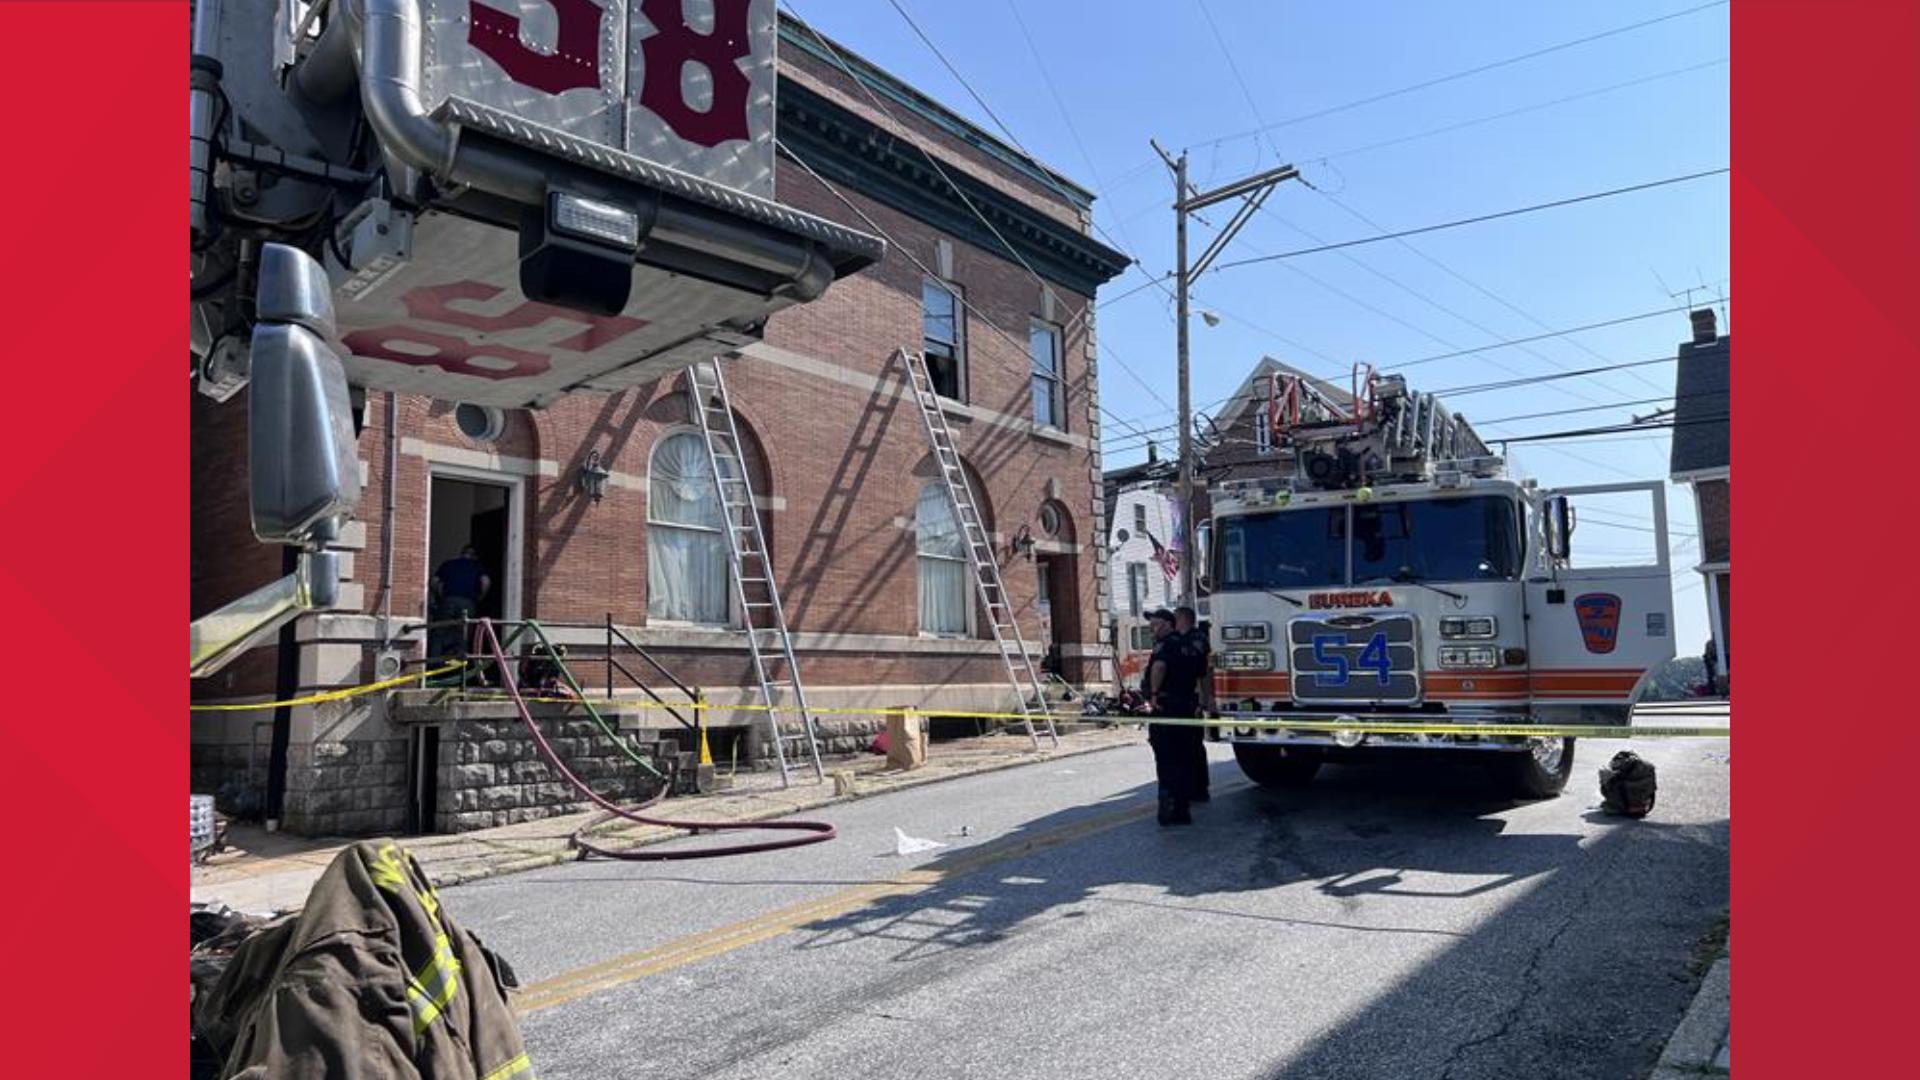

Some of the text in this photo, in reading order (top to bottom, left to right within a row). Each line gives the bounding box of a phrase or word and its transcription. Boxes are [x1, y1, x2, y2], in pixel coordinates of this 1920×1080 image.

[341, 280, 651, 379] 58
[1308, 590, 1394, 610] EUREKA
[1312, 632, 1392, 687] 54
